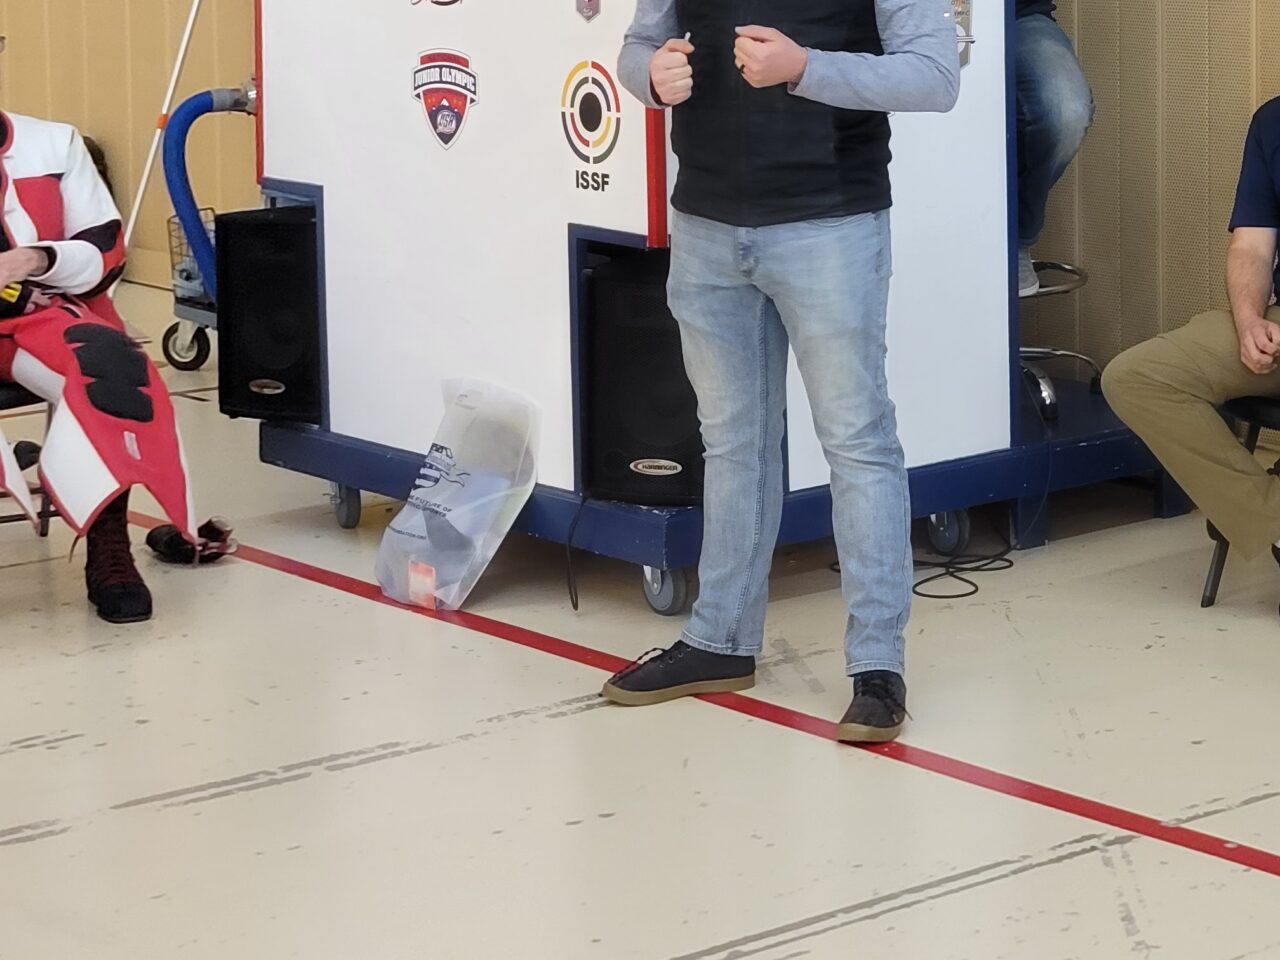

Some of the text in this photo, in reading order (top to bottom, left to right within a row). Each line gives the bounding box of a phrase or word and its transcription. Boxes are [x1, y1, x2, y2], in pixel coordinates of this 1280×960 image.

[415, 67, 475, 92] JUNIOR OLYMPIC
[575, 170, 610, 192] ISSF
